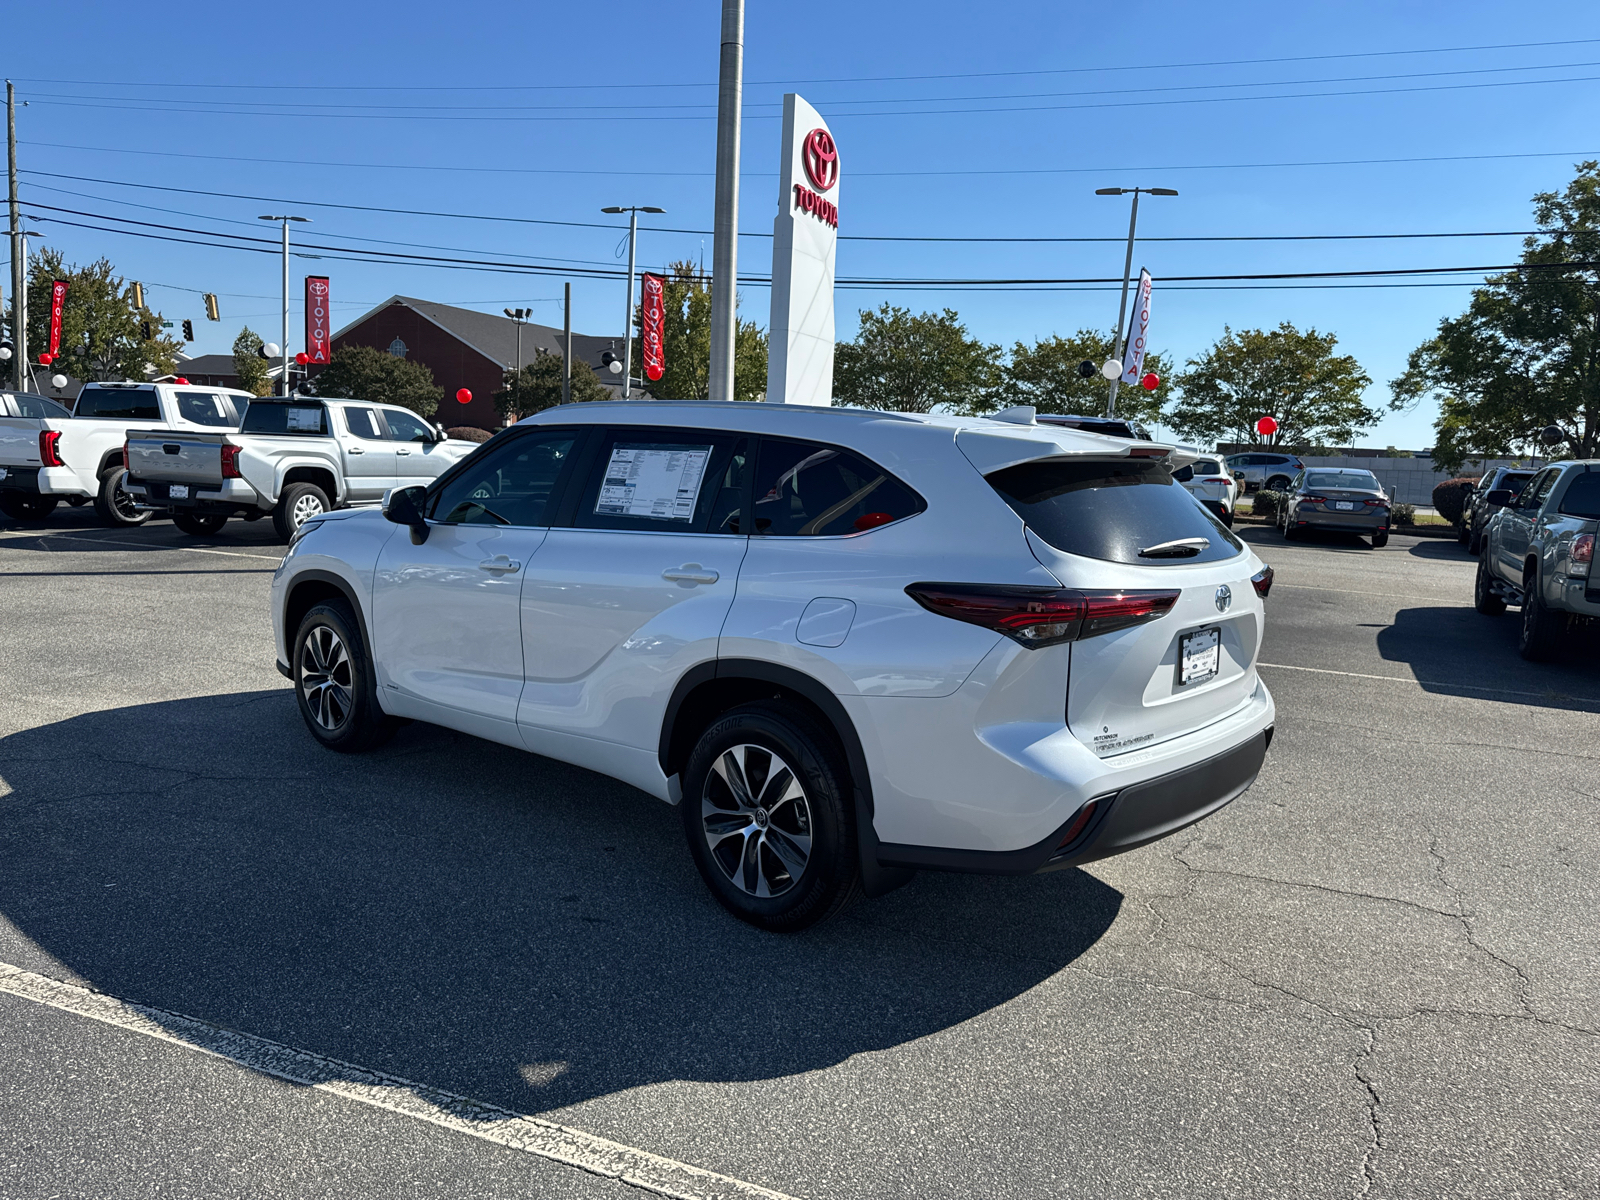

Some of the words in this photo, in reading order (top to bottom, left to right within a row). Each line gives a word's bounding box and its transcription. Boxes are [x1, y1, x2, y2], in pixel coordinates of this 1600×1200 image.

[794, 184, 838, 229] TOYOTA
[314, 297, 324, 360] TOYOTA
[650, 296, 659, 366] TOYOTA
[1127, 296, 1149, 376] TOYOTA
[690, 716, 743, 764] BRIDGESTONE
